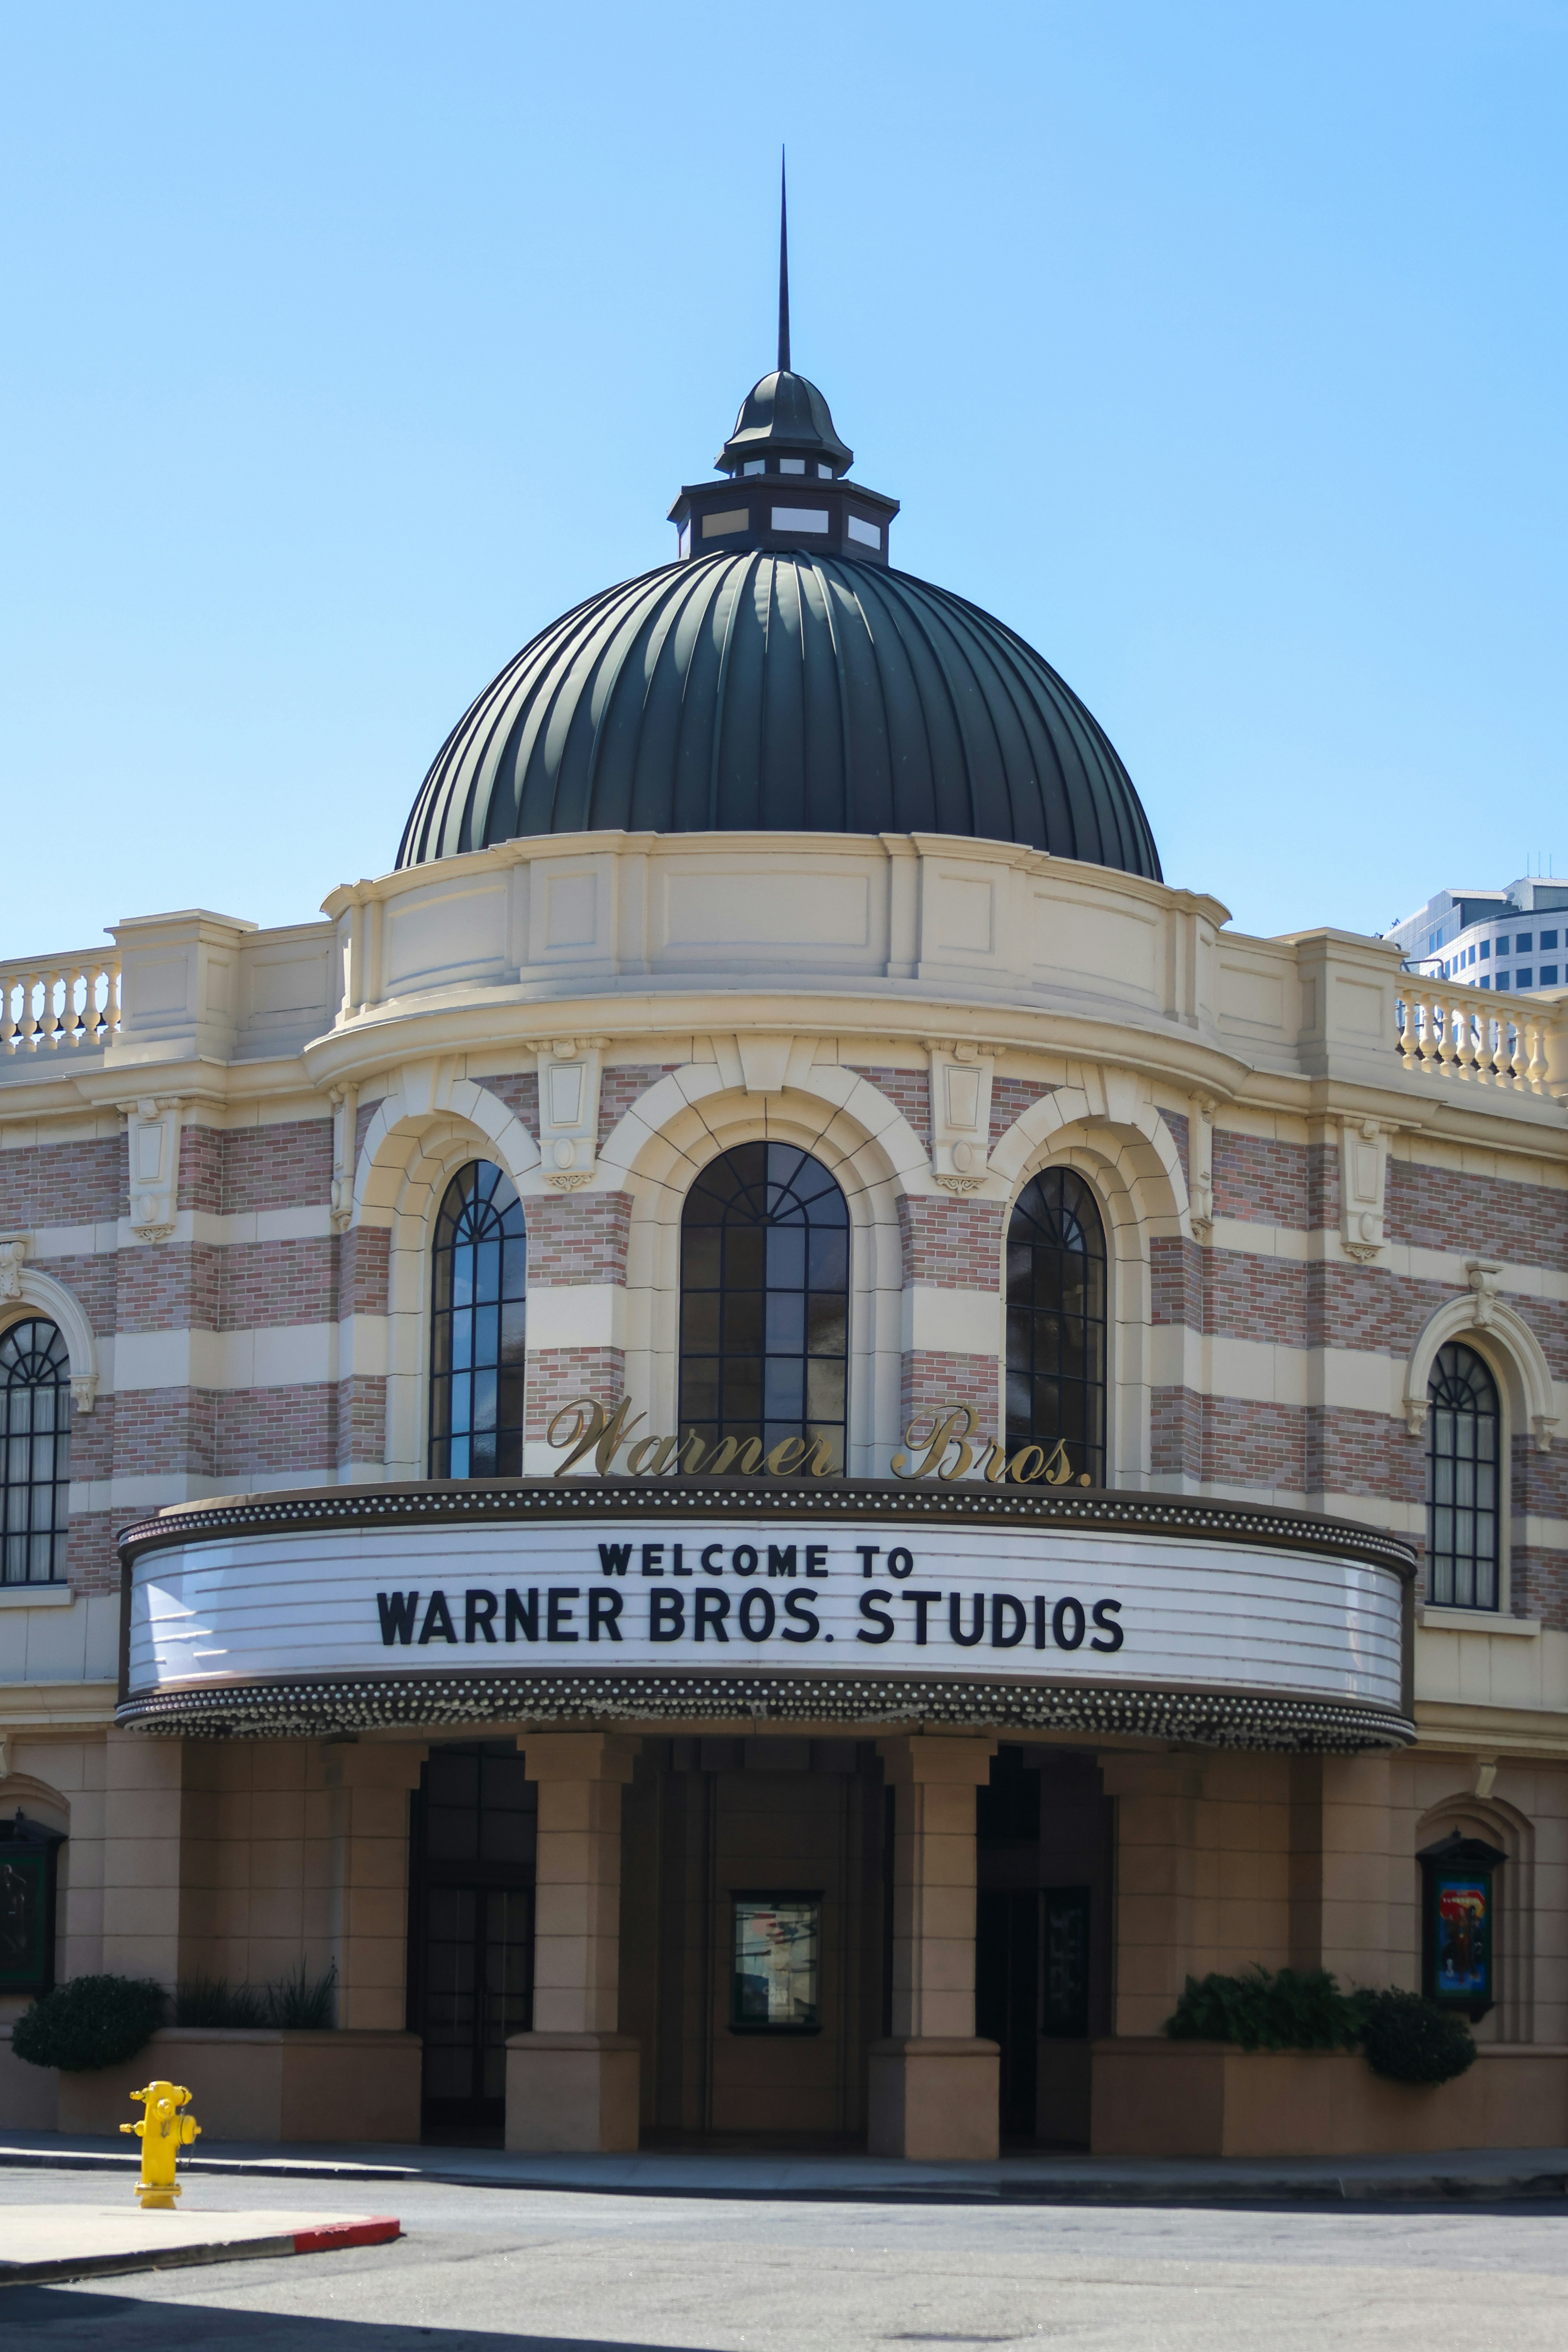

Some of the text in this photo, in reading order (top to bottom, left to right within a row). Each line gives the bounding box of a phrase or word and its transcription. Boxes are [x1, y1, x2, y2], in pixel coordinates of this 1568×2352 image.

[547, 1395, 1091, 1487] Warner Bros.
[598, 1543, 914, 1579] WELCOME TO
[376, 1587, 1124, 1653] WARNER BROS. STUDIOS
